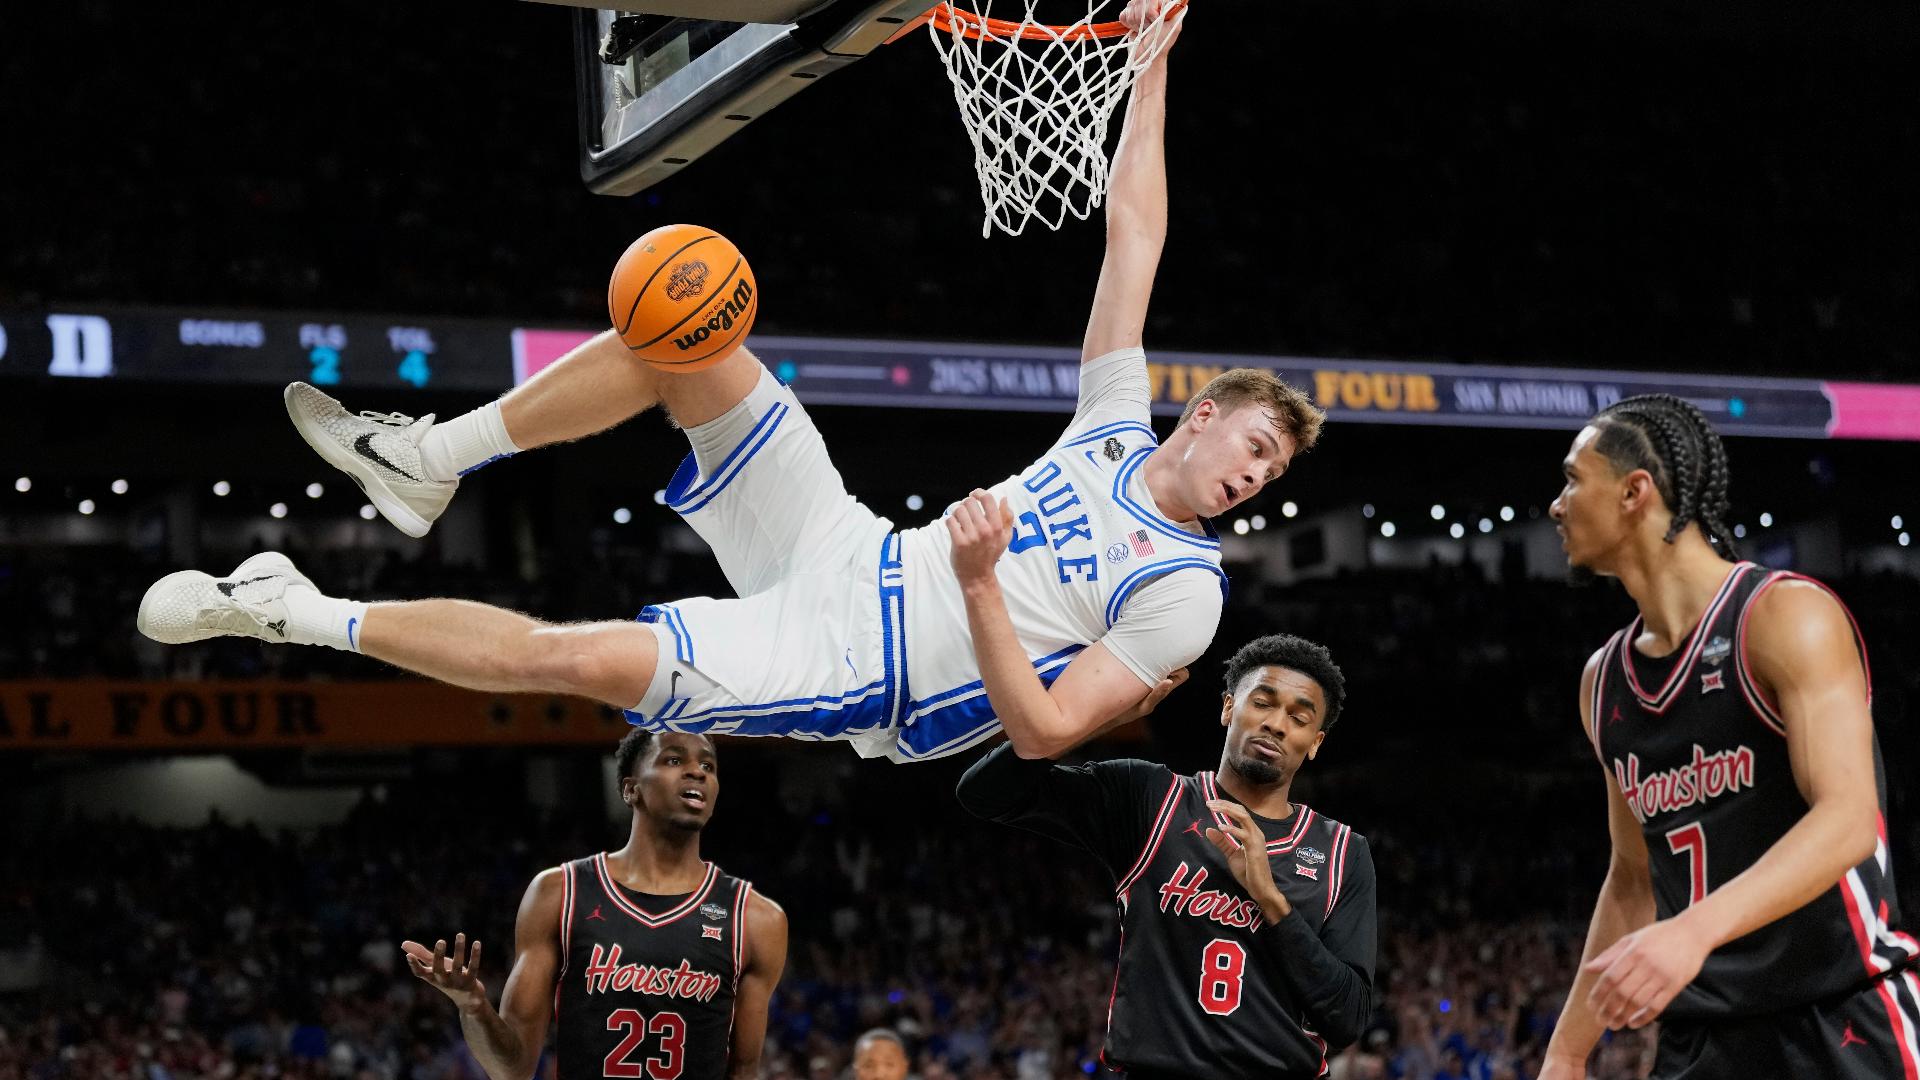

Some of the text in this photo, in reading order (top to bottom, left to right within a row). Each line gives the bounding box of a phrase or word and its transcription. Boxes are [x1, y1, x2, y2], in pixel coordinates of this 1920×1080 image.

[179, 319, 265, 347] BONUS
[673, 278, 753, 350] Wilson
[310, 346, 341, 384] 2
[398, 350, 430, 388] 4
[1313, 370, 1439, 412] FOUR
[1023, 460, 1099, 584] DUKE
[111, 691, 324, 737] FOUR
[1614, 743, 1755, 824] Houston
[1158, 860, 1266, 934] Houst
[1665, 820, 1708, 906] 7
[585, 942, 721, 1003] Houston
[1198, 937, 1247, 1016] 8
[602, 1008, 687, 1080] 23
